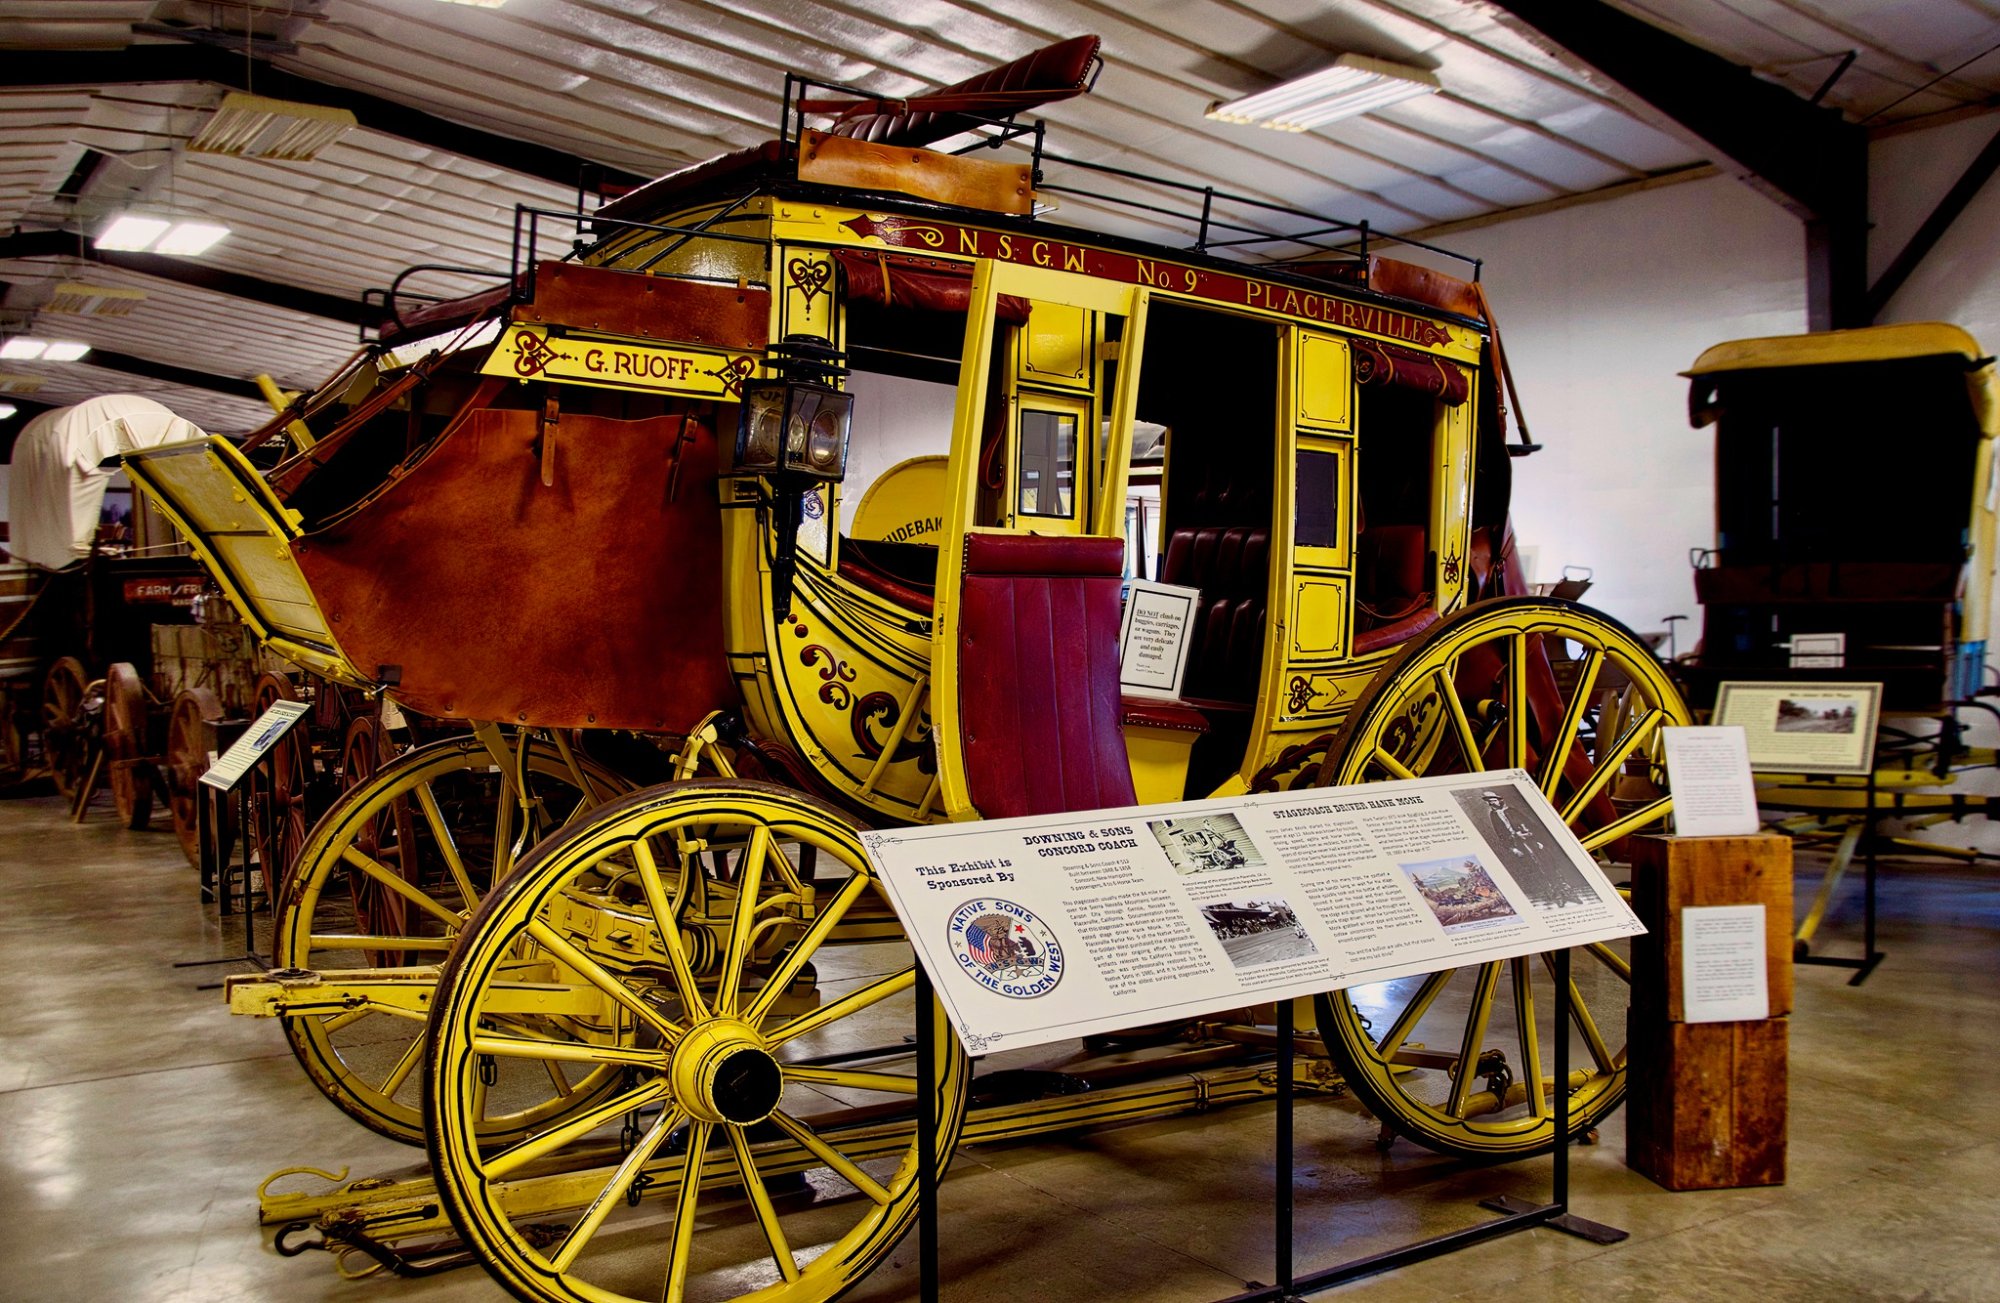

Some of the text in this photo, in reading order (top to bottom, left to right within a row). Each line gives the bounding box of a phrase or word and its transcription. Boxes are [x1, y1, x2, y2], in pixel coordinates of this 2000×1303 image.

[1246, 280, 1423, 343] PLACERVILLE
[614, 352, 694, 380] RUOFF
[1273, 796, 1424, 819] STAGECOACH DRIVER HANK MONK
[1022, 826, 1134, 846] DOWNING & SONS
[1037, 838, 1139, 858] CONCORD COACH
[915, 858, 1012, 877] This Exhibit is
[927, 871, 1015, 891] Sponsored By
[952, 902, 1033, 932] NATIVE SONS
[959, 941, 1061, 996] OF THE GOLDEN WEST
